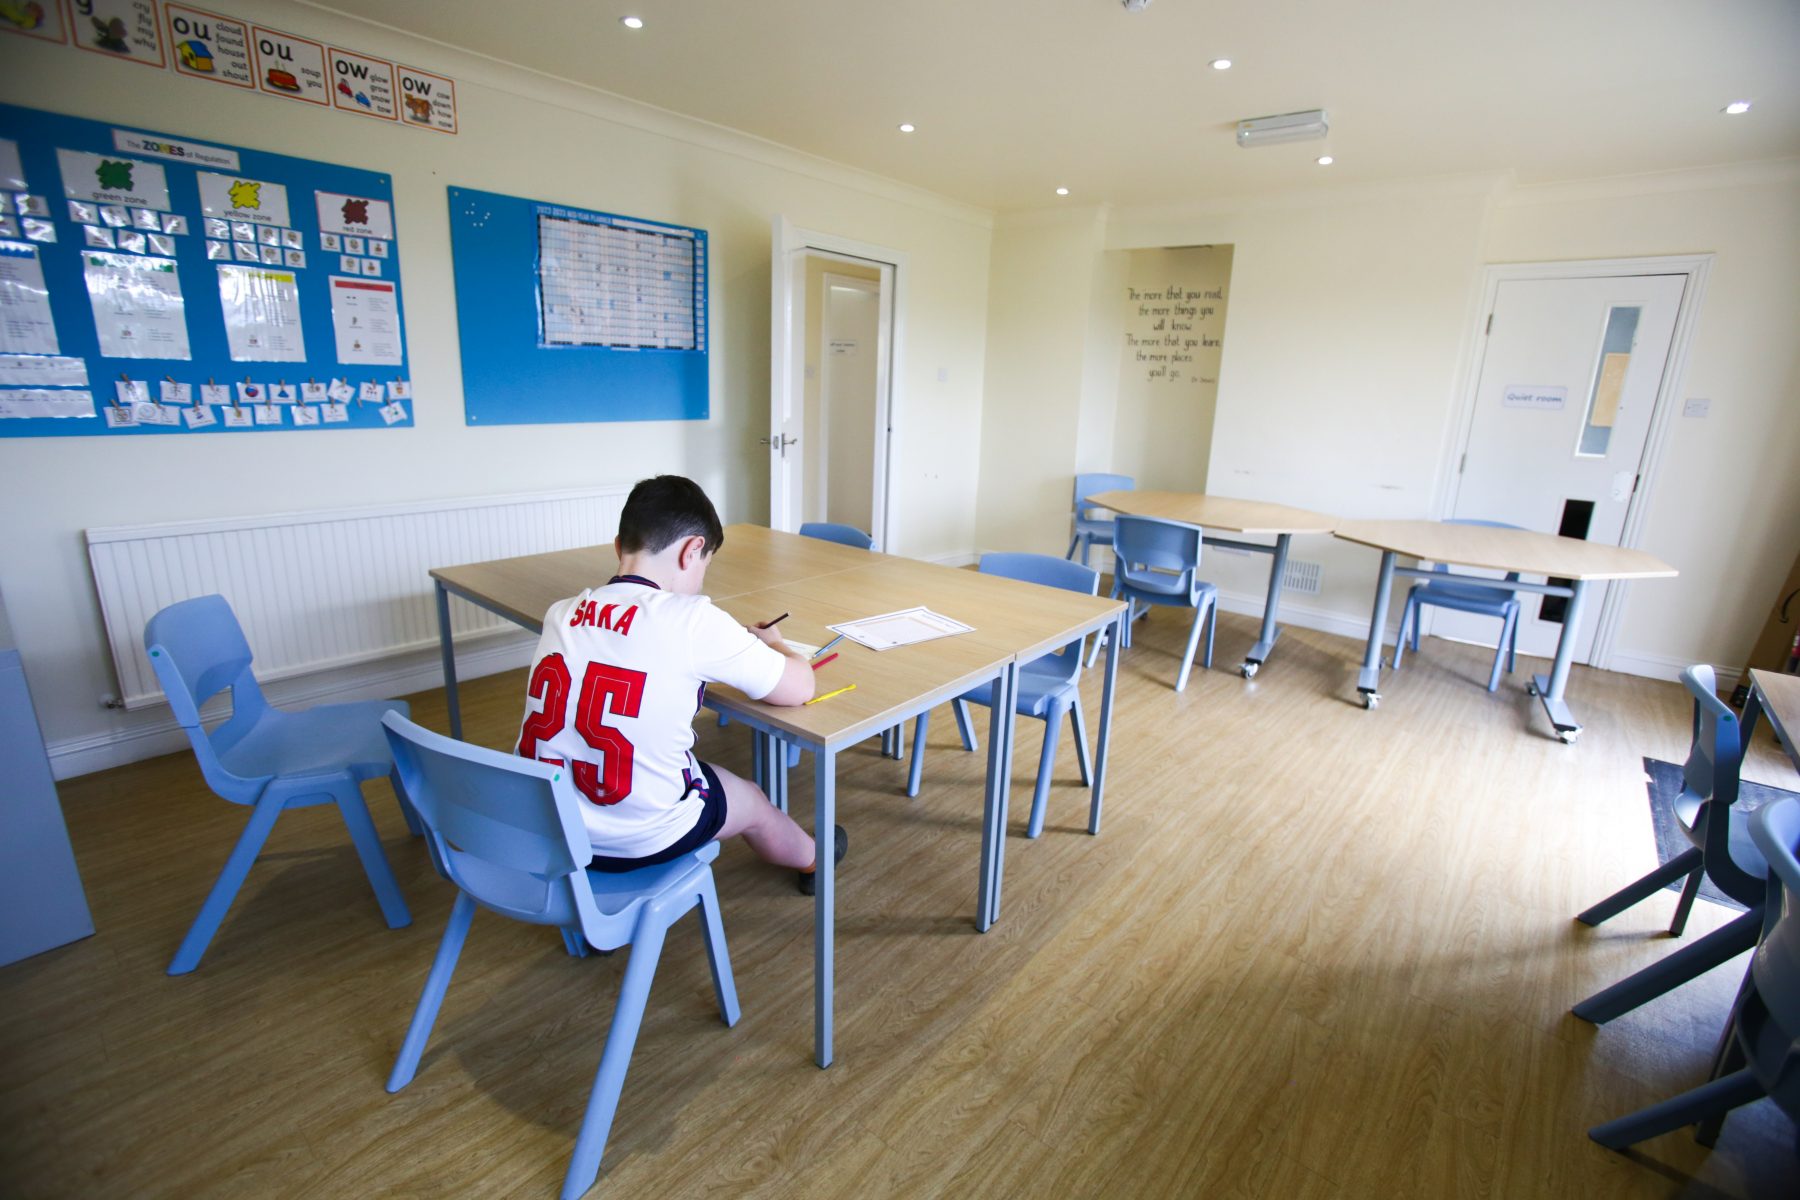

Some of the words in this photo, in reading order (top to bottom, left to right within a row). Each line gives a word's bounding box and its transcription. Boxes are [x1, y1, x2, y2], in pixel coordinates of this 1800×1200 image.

[173, 17, 212, 41] ou
[216, 22, 242, 35] cloud
[216, 33, 243, 47] found
[217, 45, 246, 59] house
[260, 39, 293, 61] ou
[231, 60, 248, 70] out
[336, 60, 369, 80] ow
[222, 69, 249, 81] shout
[301, 67, 321, 79] soup
[370, 74, 388, 84] glow
[306, 79, 322, 89] you
[370, 84, 389, 94] grow
[402, 77, 431, 96] ow
[371, 95, 390, 104] snow
[433, 100, 451, 109] down
[142, 140, 185, 156] ZONES
[92, 192, 122, 203] green
[124, 195, 147, 205] zone
[224, 209, 249, 219] yellow
[252, 214, 271, 222] zone
[356, 227, 372, 235] zone
[1128, 287, 1140, 300] The
[1144, 292, 1162, 300] more
[1166, 285, 1183, 300] that
[1185, 291, 1201, 304] you
[1139, 304, 1149, 316] the
[1152, 307, 1170, 315] more
[1174, 303, 1197, 320] things
[1200, 307, 1214, 320] you
[1153, 319, 1165, 331] will
[1171, 319, 1192, 331] know
[1126, 333, 1138, 346] The
[1164, 334, 1180, 346] that
[1184, 339, 1198, 351] you
[1136, 350, 1146, 361] the
[1171, 350, 1192, 365] places
[1507, 393, 1533, 402] Quiet
[1536, 395, 1562, 403] room
[569, 600, 639, 636] SAKA
[519, 652, 647, 806] 25
